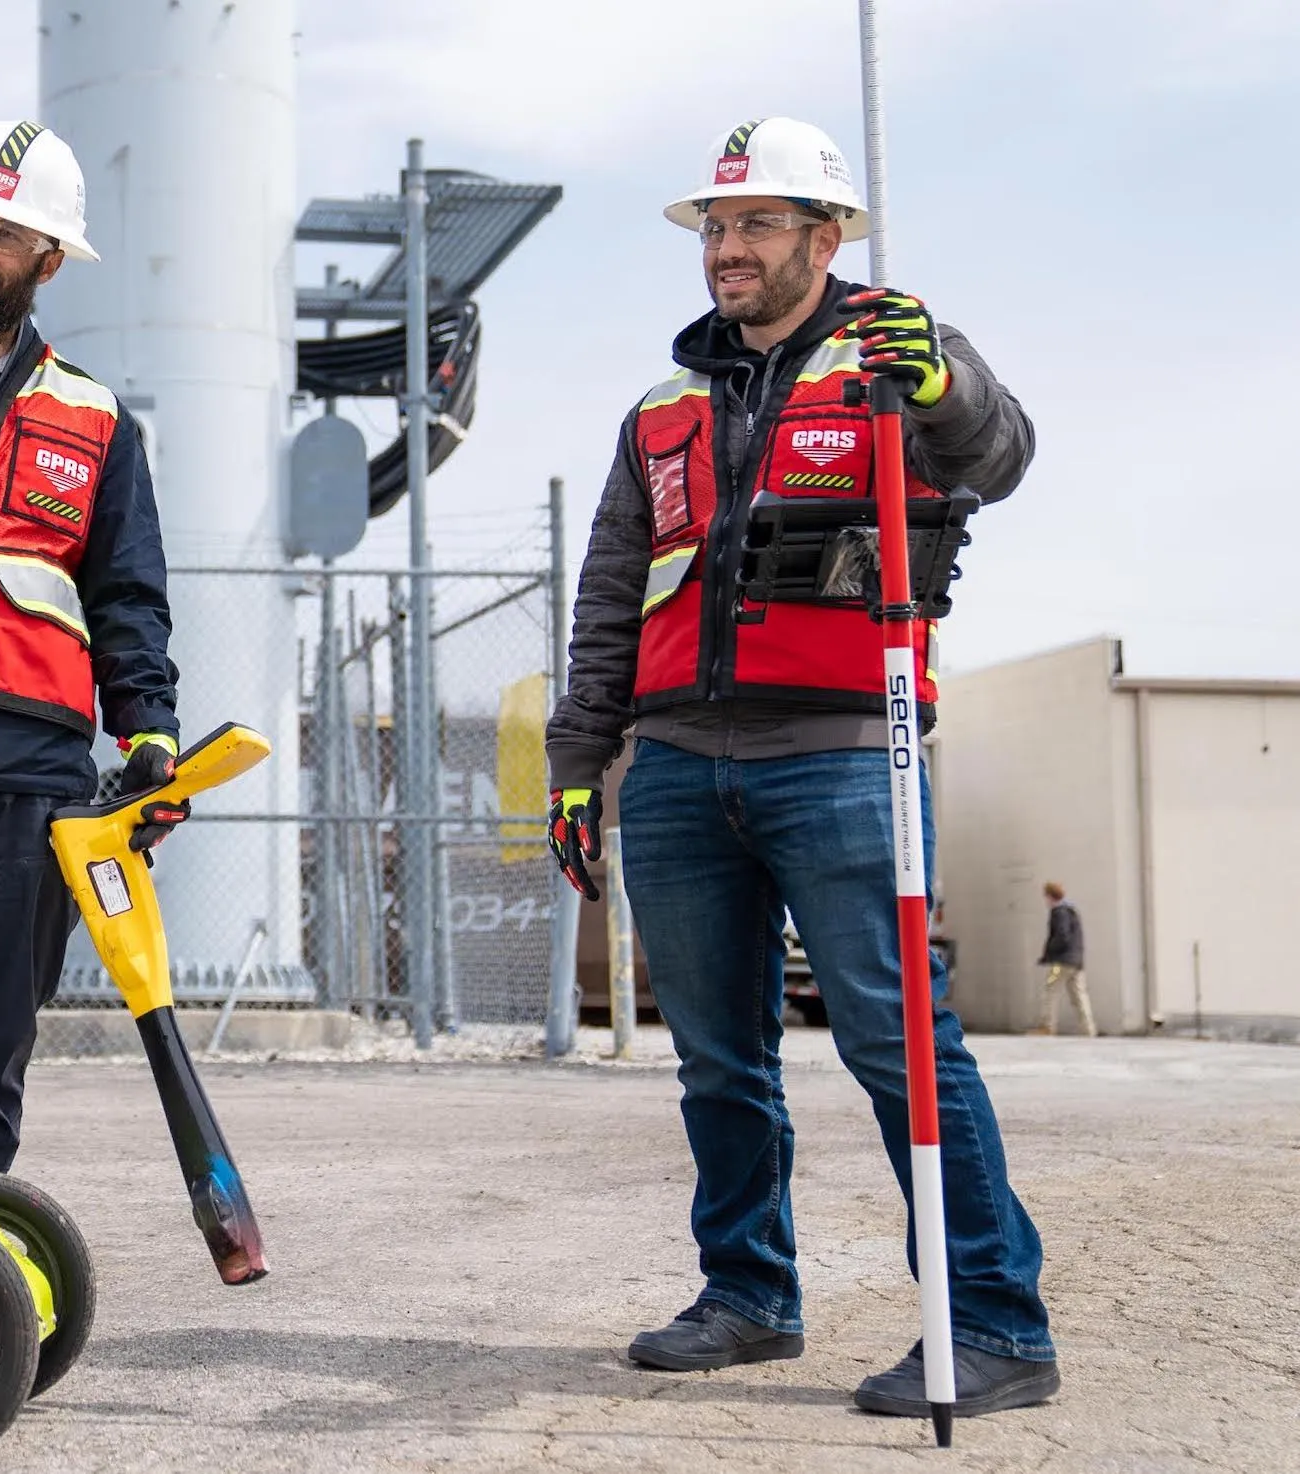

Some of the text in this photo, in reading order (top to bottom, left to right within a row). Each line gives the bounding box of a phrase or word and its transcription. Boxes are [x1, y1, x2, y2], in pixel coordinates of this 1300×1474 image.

[718, 160, 747, 171] GPRS
[791, 430, 857, 449] GPRS
[35, 448, 90, 483] GPRS
